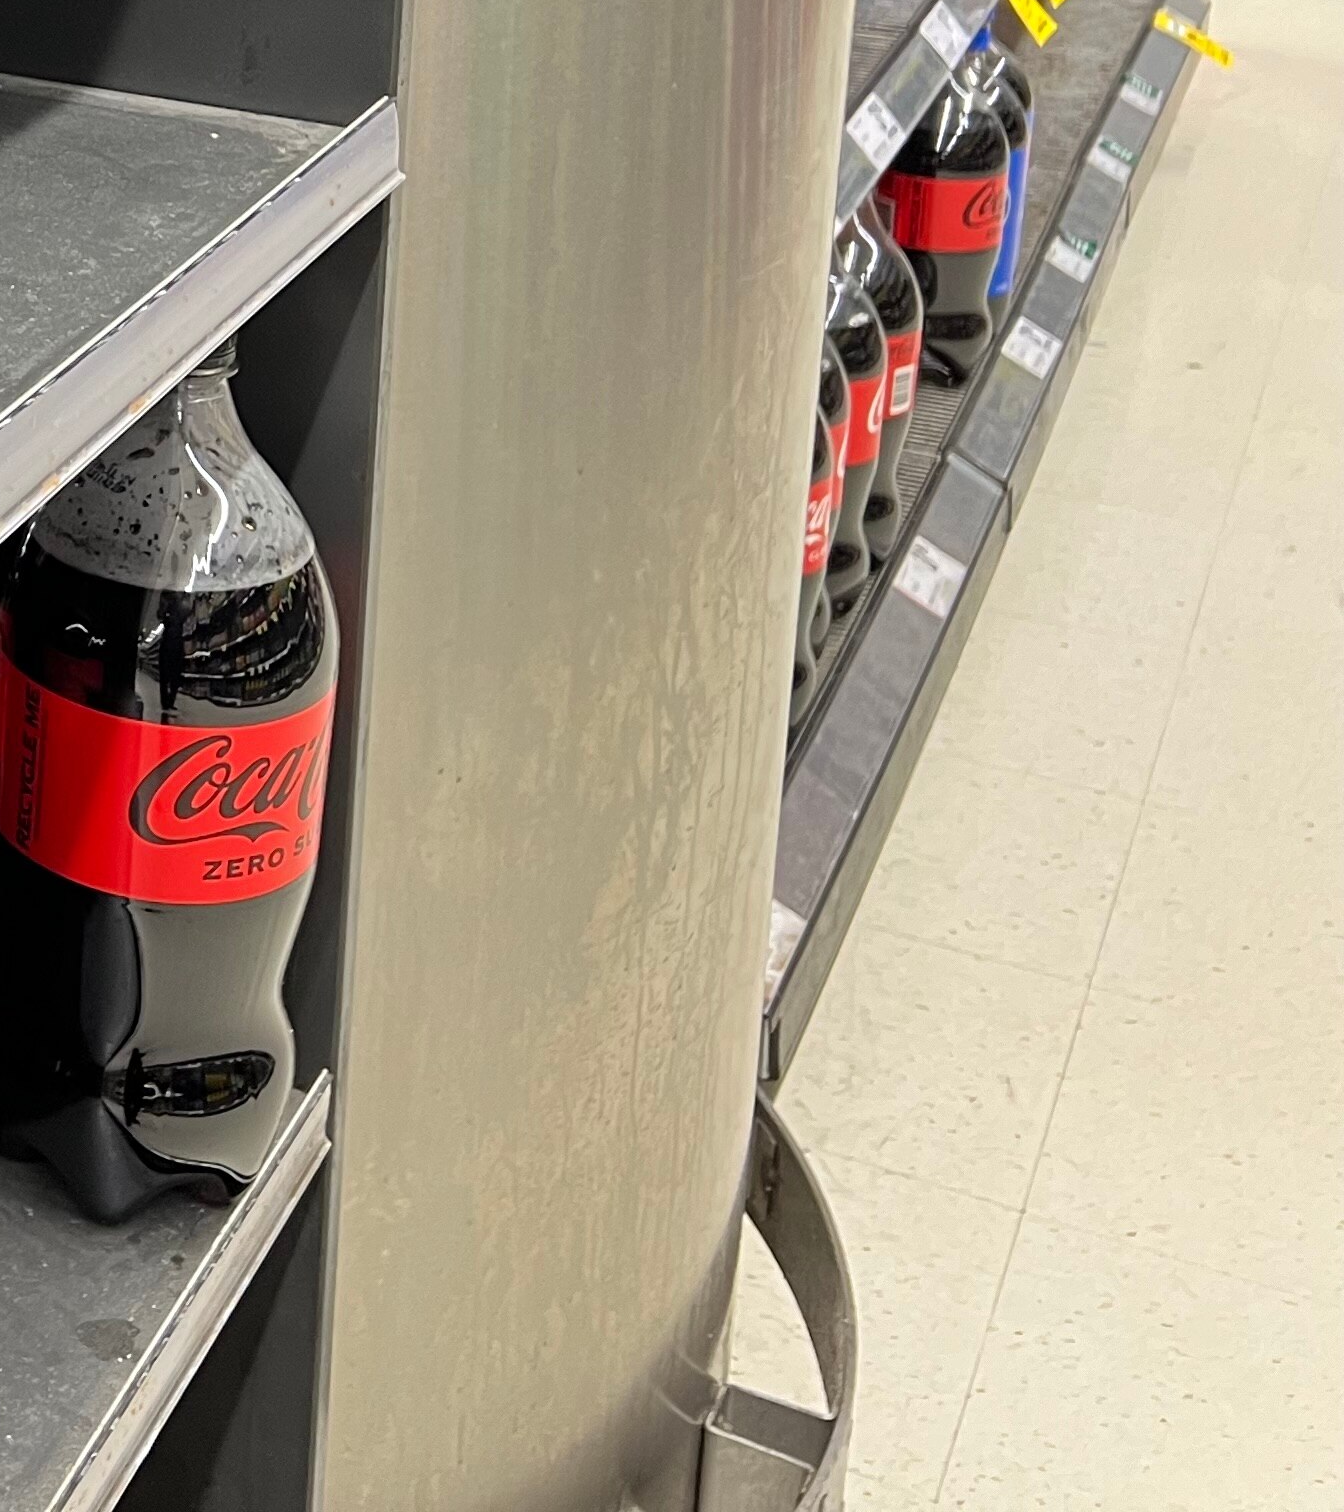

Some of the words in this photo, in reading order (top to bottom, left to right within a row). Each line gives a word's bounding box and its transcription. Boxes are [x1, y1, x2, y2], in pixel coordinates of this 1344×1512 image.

[23, 681, 41, 730] ME
[15, 731, 36, 850] RECYCLE
[203, 848, 285, 880] ZERO
